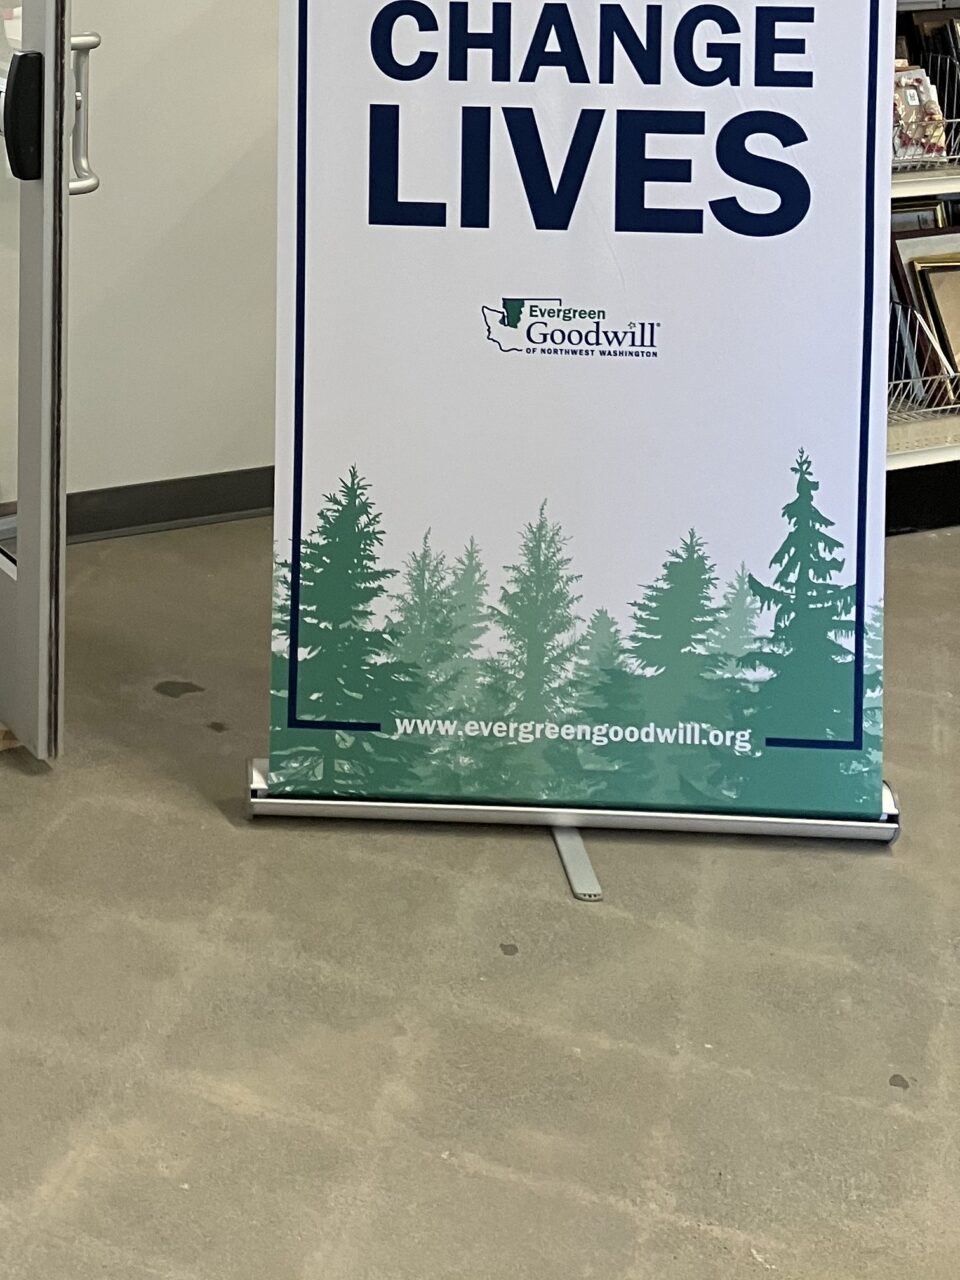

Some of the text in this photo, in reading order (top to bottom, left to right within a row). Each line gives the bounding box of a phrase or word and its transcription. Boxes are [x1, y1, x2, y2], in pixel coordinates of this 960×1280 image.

[370, 0, 815, 88] CHANGE
[368, 103, 811, 238] LIVES
[529, 304, 606, 322] Evergreen
[525, 321, 657, 348] Goodwill
[525, 347, 658, 358] OF NORTHWEST WASHINGTON
[394, 717, 752, 753] www.evergreengoodwill.org
